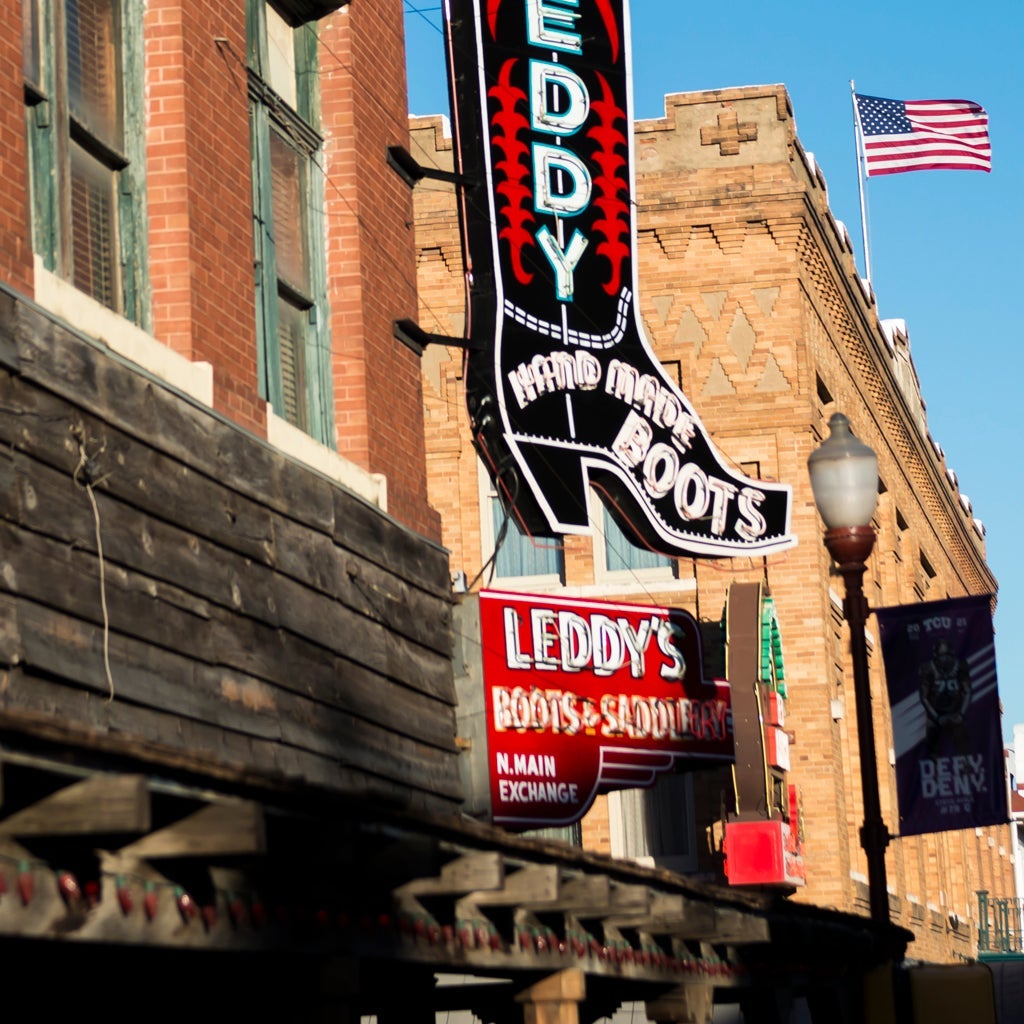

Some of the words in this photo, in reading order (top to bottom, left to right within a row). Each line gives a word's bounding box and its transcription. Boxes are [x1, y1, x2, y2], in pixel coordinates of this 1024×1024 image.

[507, 349, 601, 409] HAND
[605, 359, 698, 454] MADE
[612, 409, 767, 541] BOOTS
[503, 607, 686, 678] LEDDY'S
[922, 616, 952, 632] TCU
[491, 686, 583, 736] BOOTS
[600, 694, 727, 741] SADDLERY
[499, 779, 579, 804] EXCHANGE
